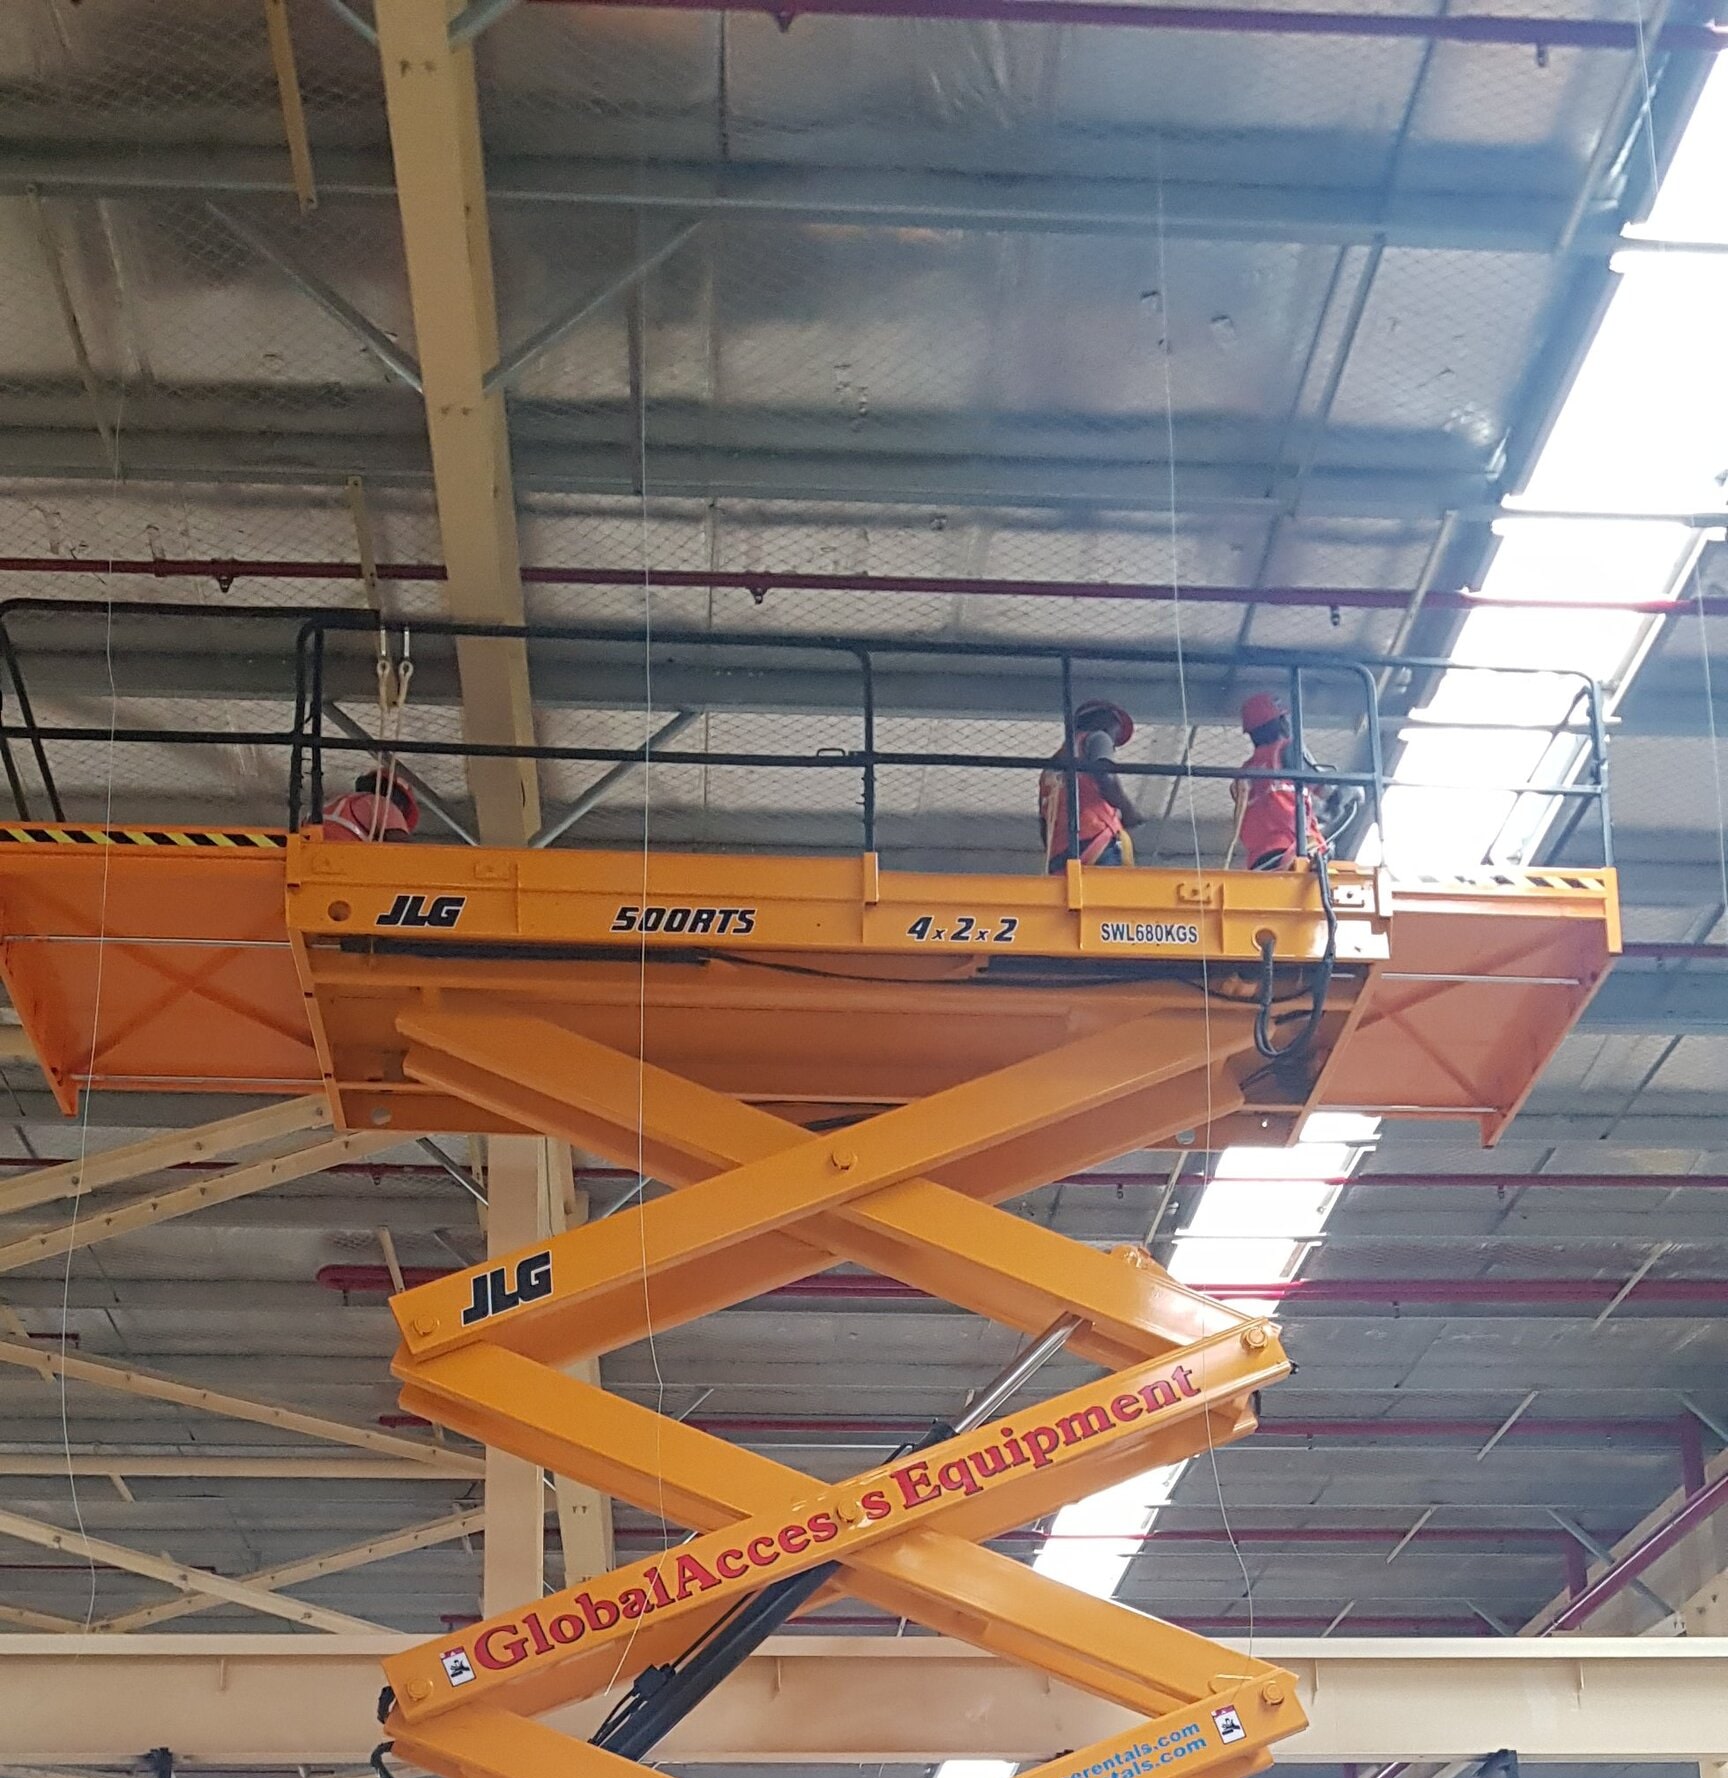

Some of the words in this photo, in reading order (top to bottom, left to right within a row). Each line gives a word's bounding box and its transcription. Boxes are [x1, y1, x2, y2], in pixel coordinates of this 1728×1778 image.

[376, 895, 467, 928] JLG
[610, 906, 757, 934] 500RTS
[1100, 922, 1199, 945] SWL680KGS
[461, 1250, 552, 1327] JLG
[890, 1365, 1201, 1510] Equipment
